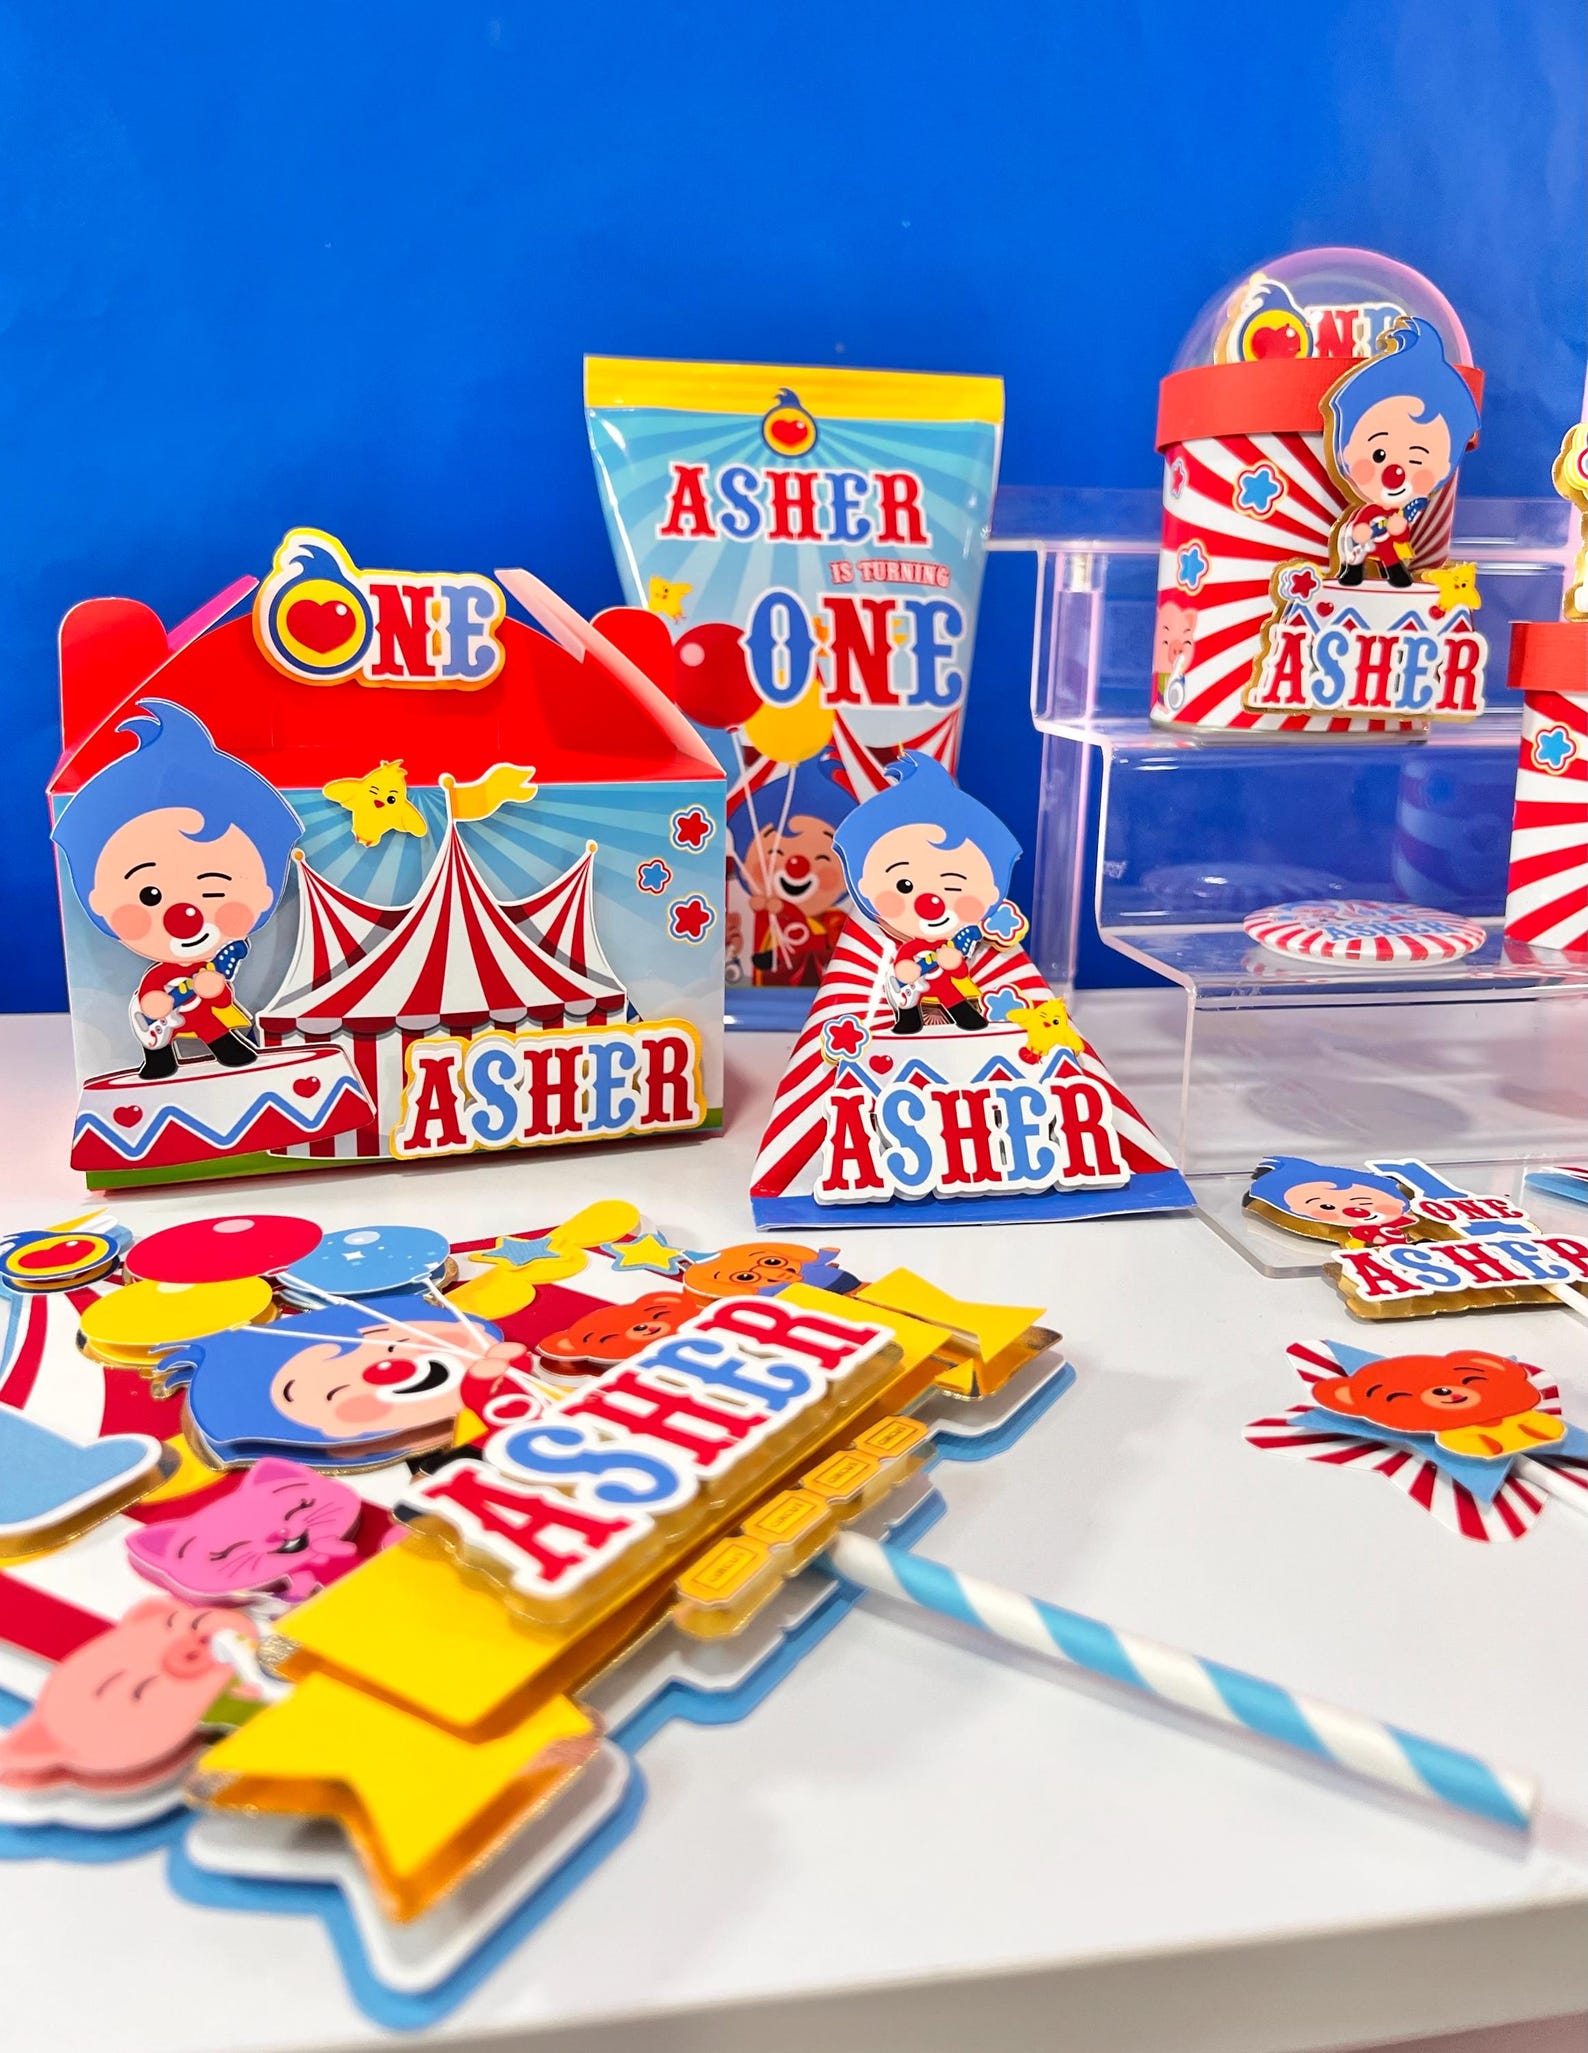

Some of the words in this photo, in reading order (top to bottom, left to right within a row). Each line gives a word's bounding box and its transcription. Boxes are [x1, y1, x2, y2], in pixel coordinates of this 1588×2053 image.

[659, 465, 930, 545] ASHER
[268, 544, 496, 677] ONE
[829, 560, 854, 584] IS
[857, 559, 952, 588] TURNING
[745, 590, 966, 708] ONE
[1261, 630, 1480, 711] ASHER
[1323, 920, 1460, 941] ASHER
[403, 1036, 693, 1150] ASHER
[822, 1083, 1121, 1192] ASHER
[1419, 1199, 1524, 1221] ONE
[422, 1299, 883, 1582] ASHER
[708, 1551, 745, 1584] CIRCUS
